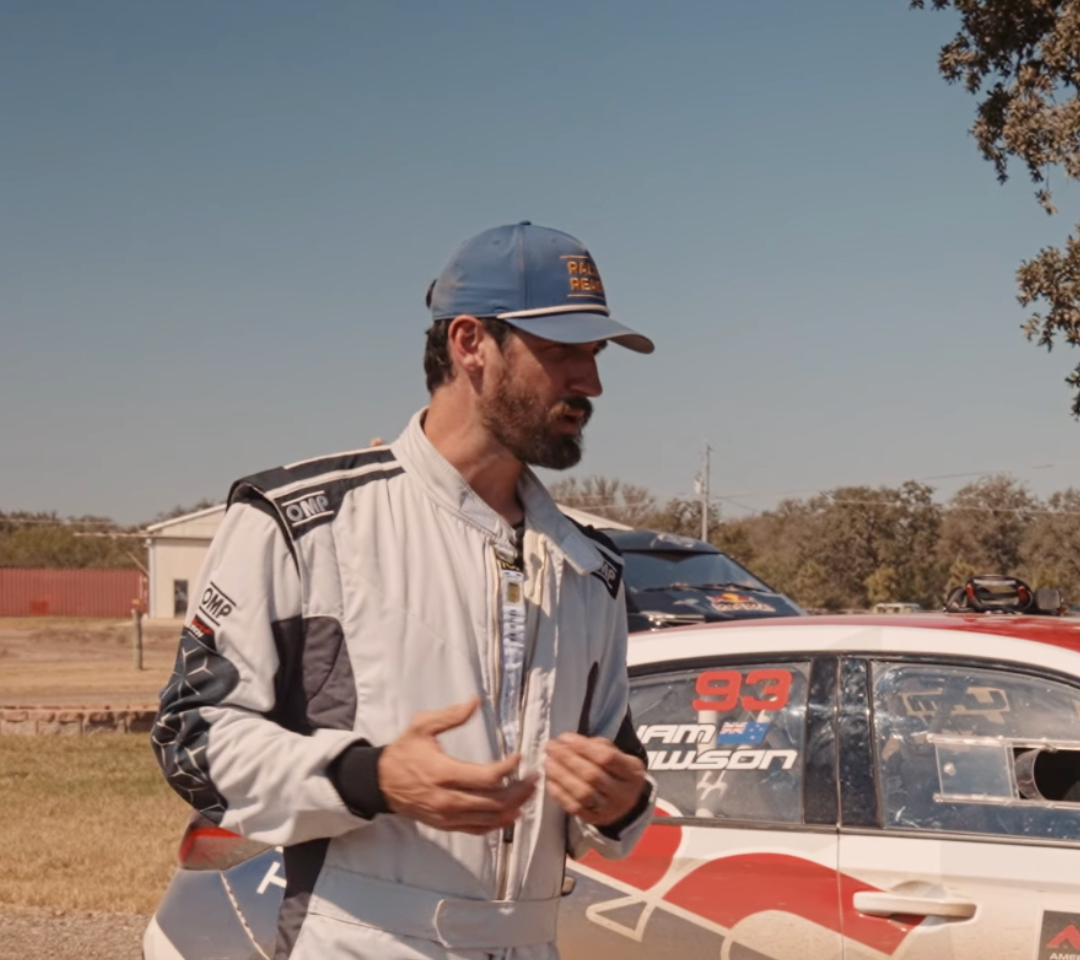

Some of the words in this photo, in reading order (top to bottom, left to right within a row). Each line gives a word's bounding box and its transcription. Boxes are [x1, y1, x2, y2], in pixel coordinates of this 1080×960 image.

[286, 495, 329, 522] OMP
[600, 564, 616, 582] MP
[202, 587, 232, 619] OMP
[691, 669, 793, 712] 93
[636, 724, 716, 744] IAM
